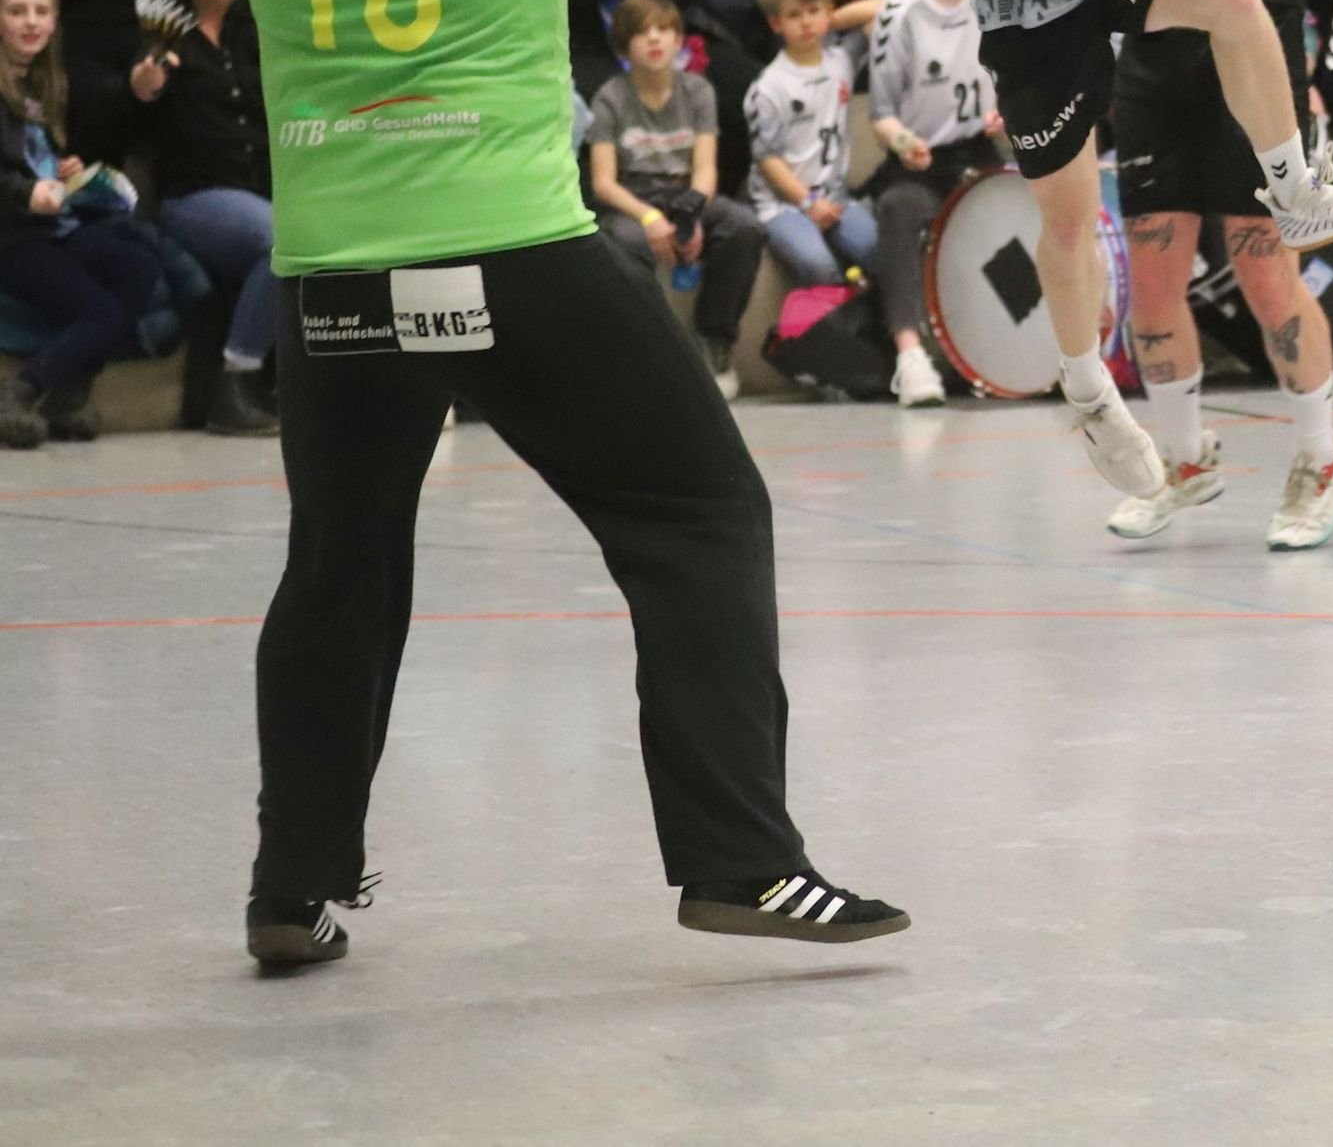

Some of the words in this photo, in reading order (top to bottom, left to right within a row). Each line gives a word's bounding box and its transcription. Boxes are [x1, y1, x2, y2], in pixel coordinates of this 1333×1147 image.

[954, 78, 983, 123] 21
[334, 118, 368, 133] GHD
[337, 313, 361, 327] und
